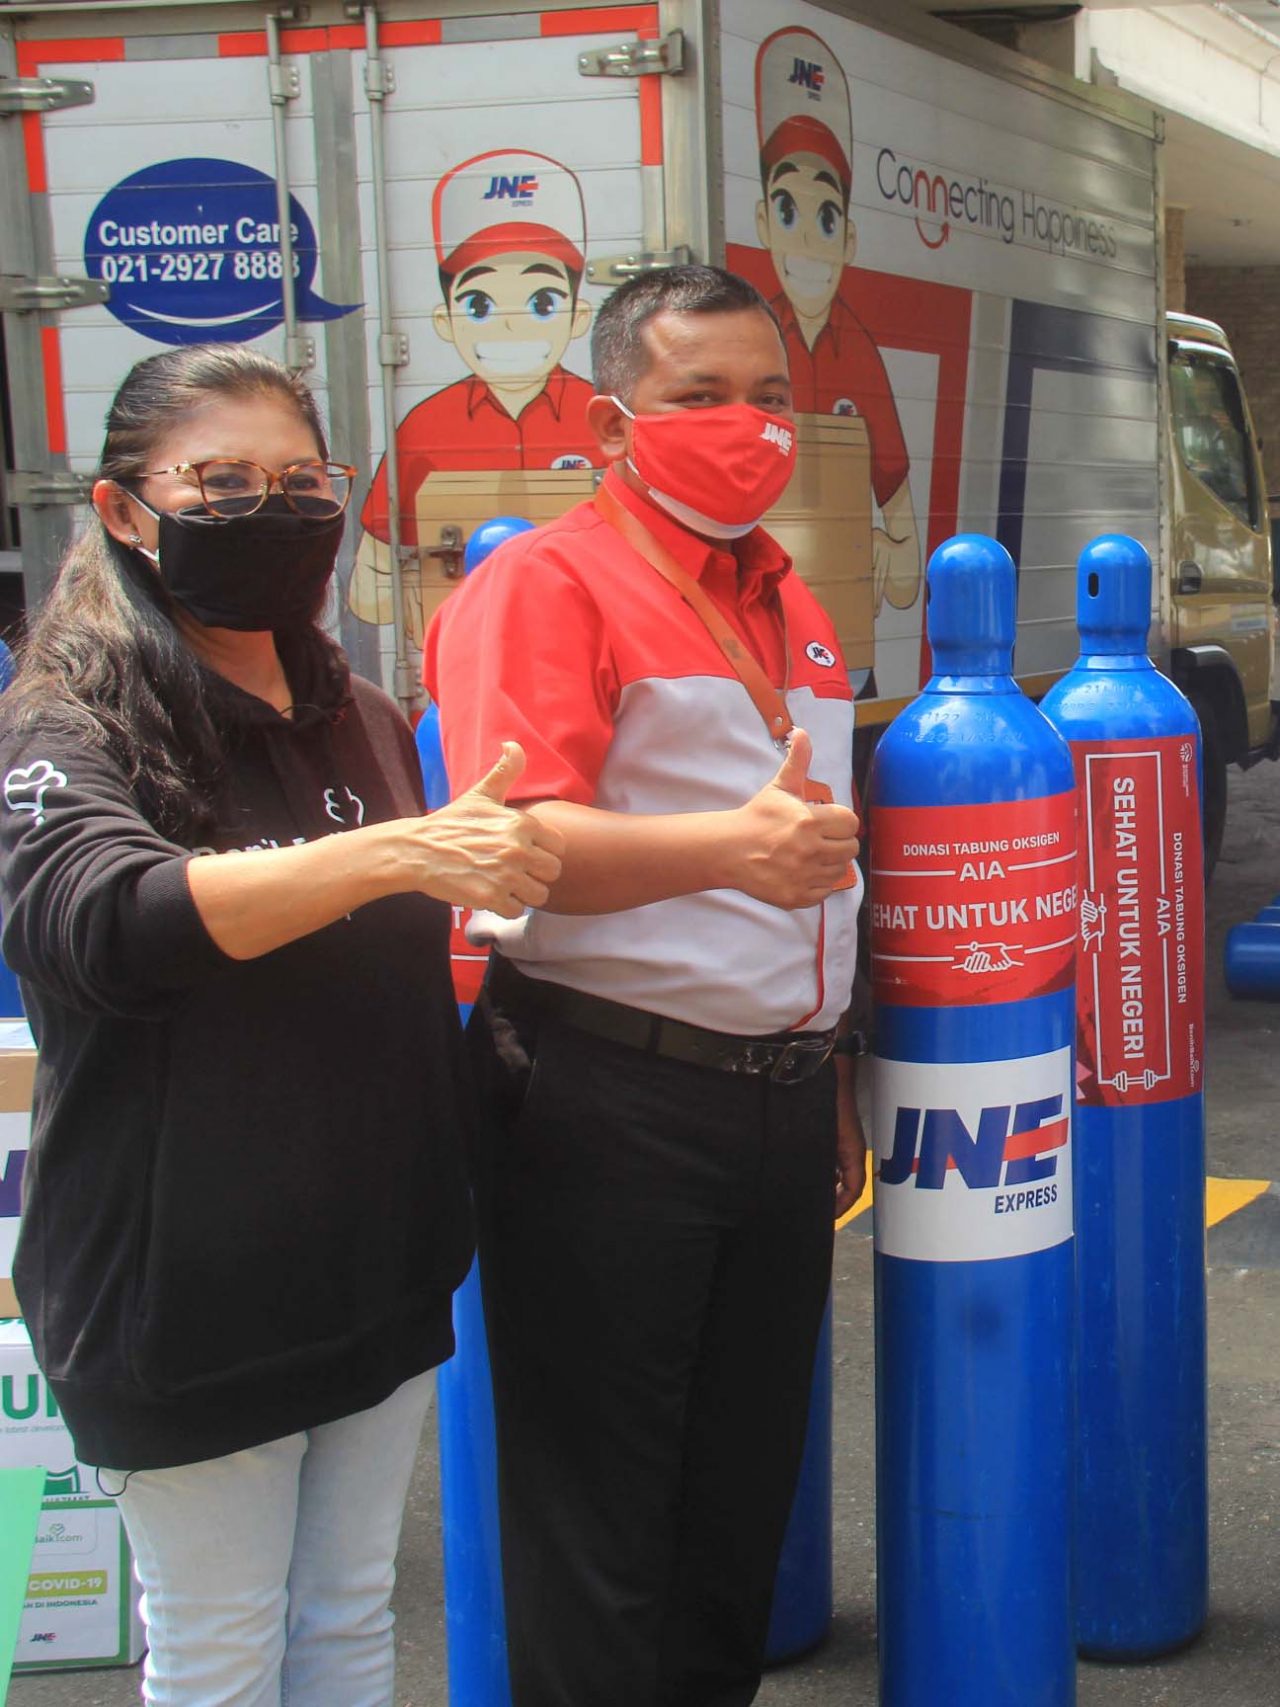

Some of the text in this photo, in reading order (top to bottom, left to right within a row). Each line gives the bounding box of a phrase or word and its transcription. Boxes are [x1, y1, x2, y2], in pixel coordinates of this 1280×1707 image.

[482, 175, 539, 200] JNE
[876, 148, 1117, 258] Connecting Happiness
[99, 219, 229, 247] Customer
[102, 253, 224, 283] 021-2927
[903, 832, 1060, 856] DONASI TABUNG OKSIGEN
[959, 860, 1006, 882] AIA
[873, 883, 1078, 930] EHAT UNTUK NEGE
[1113, 777, 1144, 1059] SEHAT UNTUK NEGERI
[1156, 898, 1171, 936] AIA
[1173, 832, 1187, 1004] DONASI TABUNG OKSIGEN
[879, 1093, 1069, 1190] JNE
[995, 1184, 1058, 1214] EXPRESS
[29, 1577, 102, 1591] COVID-19
